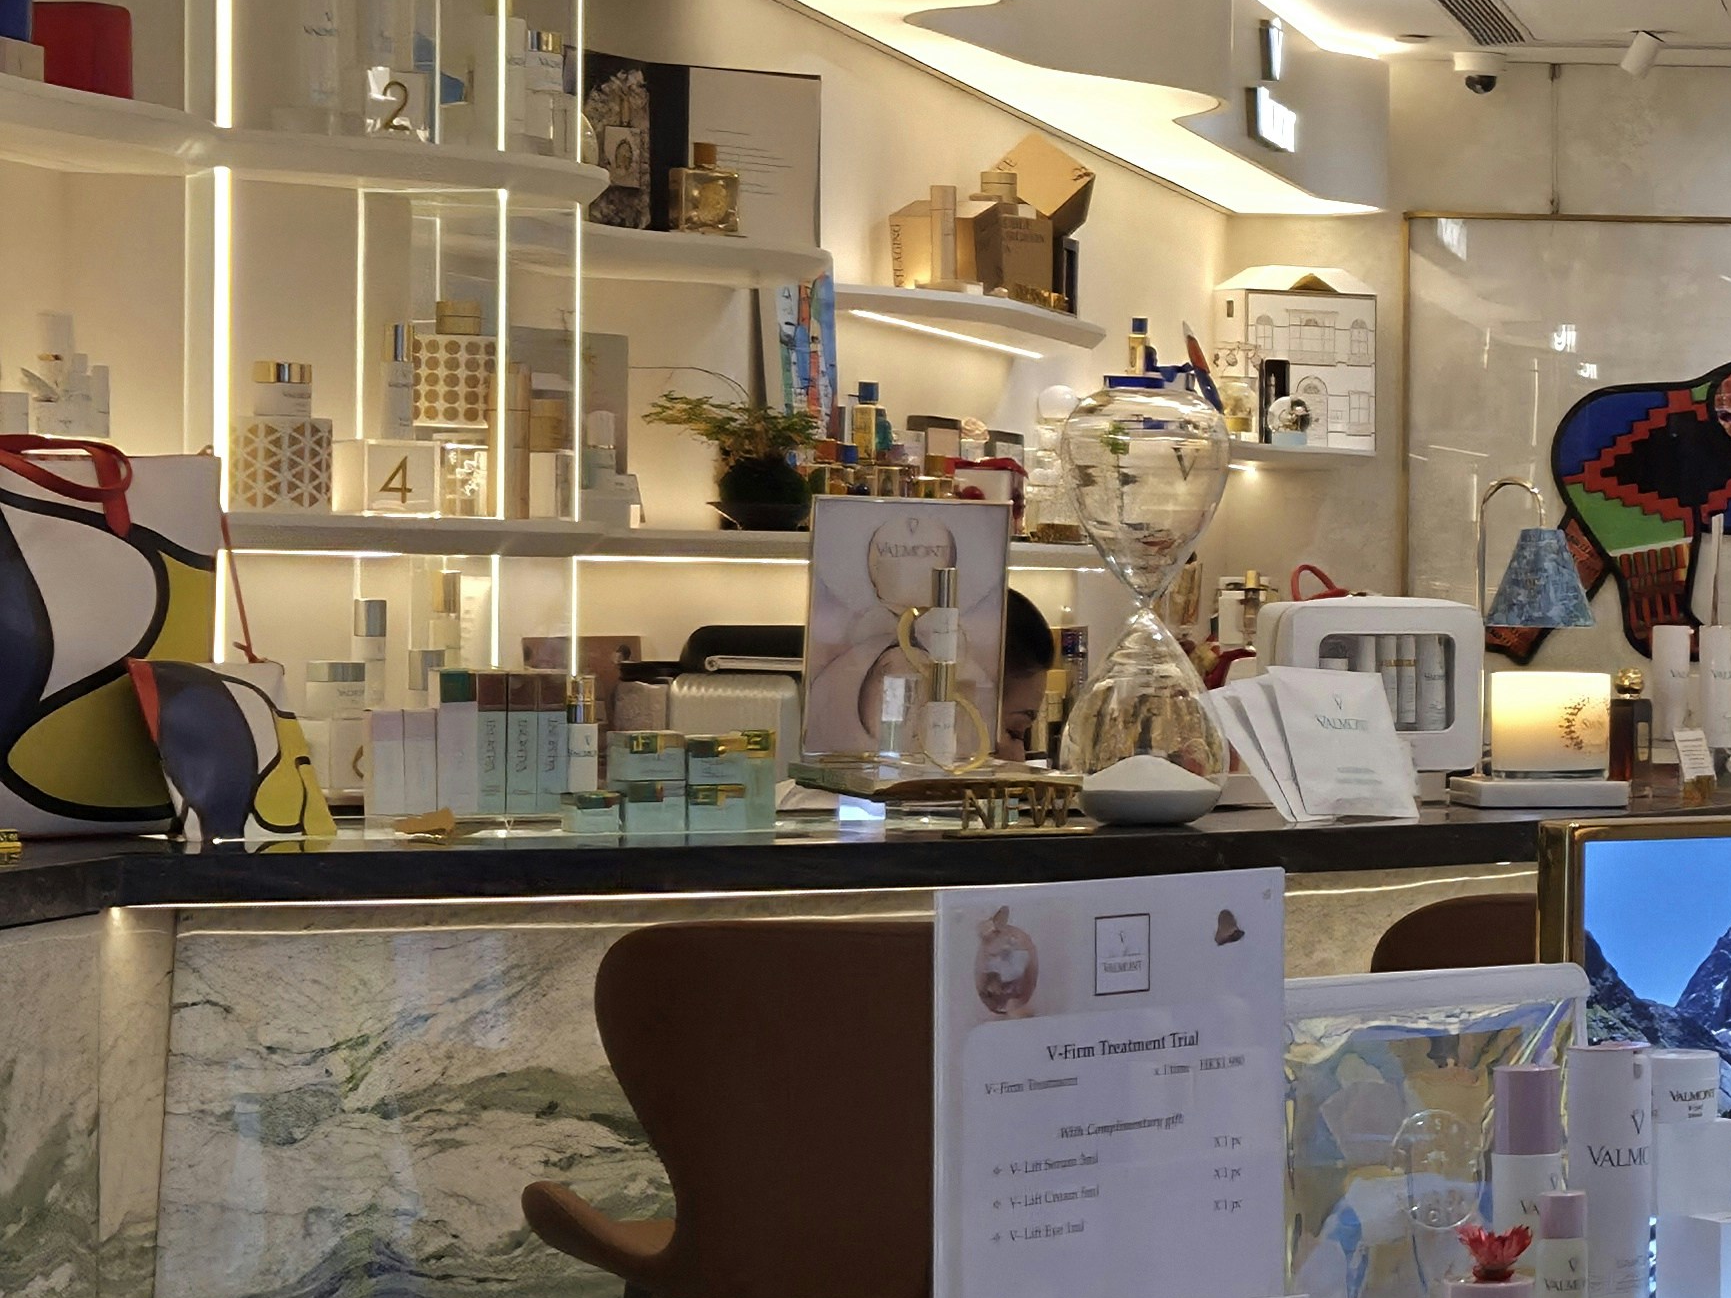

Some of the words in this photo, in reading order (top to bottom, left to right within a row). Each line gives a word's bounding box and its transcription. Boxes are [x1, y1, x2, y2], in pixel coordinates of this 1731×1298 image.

[382, 80, 411, 134] 2
[380, 454, 414, 506] 4
[1099, 1035, 1166, 1057] Treatment
[1170, 1030, 1200, 1049] Trial
